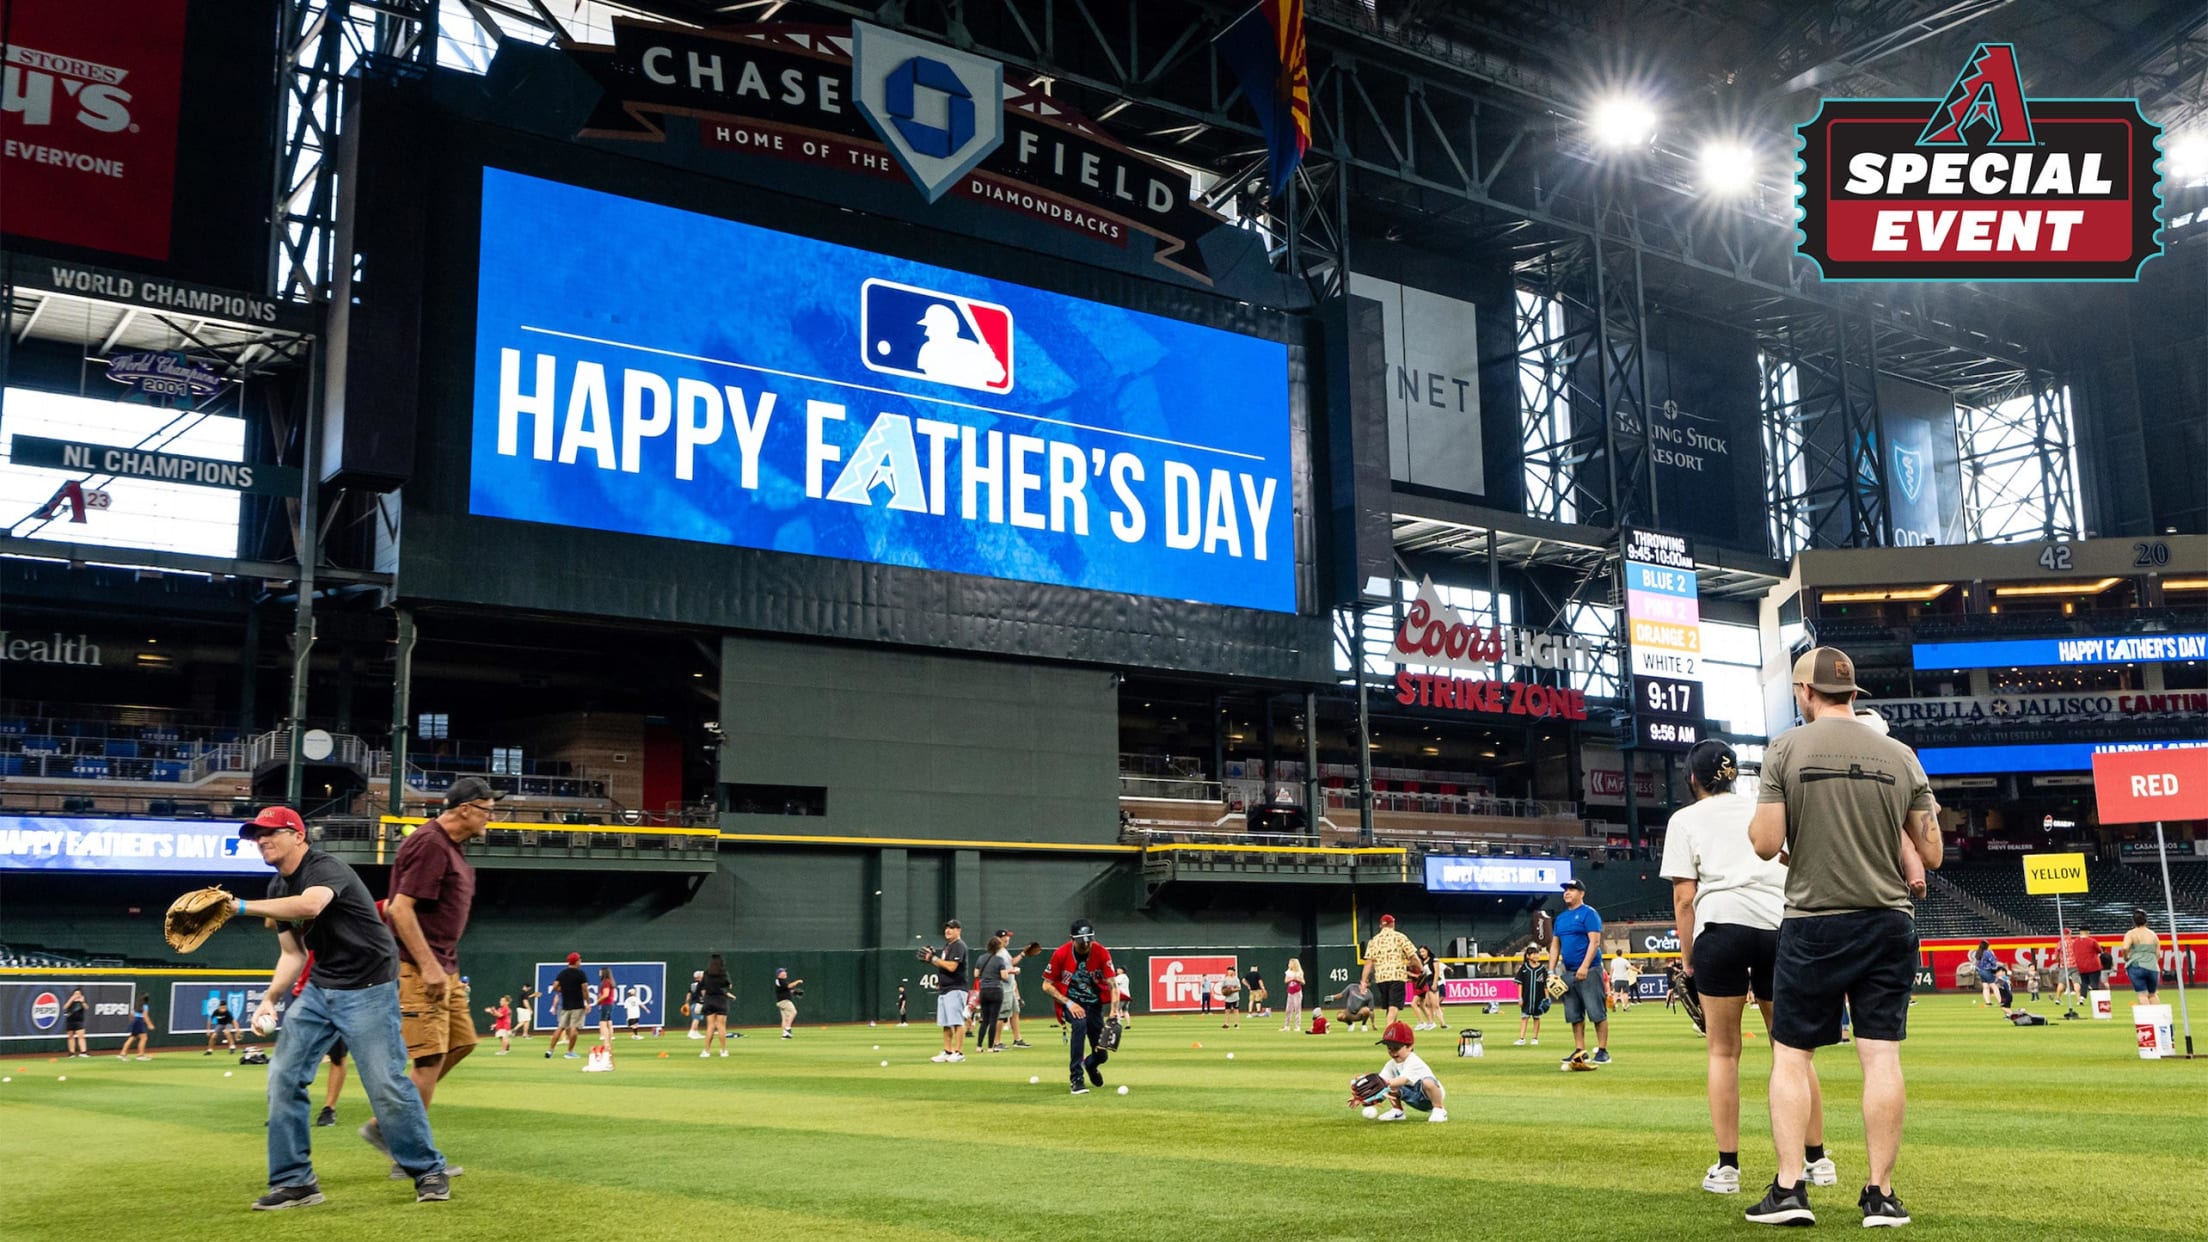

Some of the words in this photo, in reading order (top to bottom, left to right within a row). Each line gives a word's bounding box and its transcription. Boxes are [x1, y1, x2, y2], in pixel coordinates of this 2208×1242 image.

[19, 49, 118, 83] STORES
[641, 46, 842, 114] CHASE
[1018, 133, 1174, 214] FIELD
[5, 139, 124, 178] EVERYONE
[716, 127, 784, 151] HOME
[802, 142, 831, 159] OF
[848, 151, 890, 172] THE
[971, 180, 1121, 240] DIAMONDBACKS
[52, 267, 134, 298] WORLD
[141, 282, 277, 321] CHAMPIONS
[112, 354, 157, 372] World
[157, 355, 221, 385] Champions
[143, 378, 188, 396] 2001
[1386, 363, 1470, 413] NET
[1687, 427, 1728, 455] STICK
[63, 446, 95, 471] NL
[104, 450, 253, 487] CHAMPIONS
[497, 347, 777, 490] HAPPY
[806, 399, 1147, 544] FATHER'S
[1164, 460, 1277, 561] DAY
[87, 491, 110, 509] 23
[1633, 530, 1686, 553] THROWING
[2134, 541, 2170, 567] 20
[2040, 545, 2073, 570] 42
[1642, 569, 1674, 591] BLUE
[1677, 575, 1686, 592] 2
[1676, 601, 1686, 620] 2
[1396, 598, 1504, 662] Coors
[1505, 624, 1593, 673] LIGHT
[1636, 623, 1685, 647] ORANGE
[1688, 630, 1697, 649] 2
[2058, 640, 2103, 662] HAPPY
[2106, 638, 2177, 660] FATHER'S
[2178, 637, 2206, 658] DAY
[1643, 652, 1682, 673] WHITE
[1686, 658, 1694, 675] 2
[1396, 672, 1503, 711] STRIKE
[1507, 682, 1588, 721] ZONE
[1648, 681, 1690, 712] 9:17
[2016, 697, 2112, 716] JALISCO
[1650, 724, 1676, 742] 9:56
[1678, 727, 1695, 744] AM
[2131, 773, 2179, 797] RED
[176, 834, 221, 858] DAY
[2134, 842, 2178, 850] CASAMOS
[2031, 867, 2081, 881] YELLOW
[1330, 969, 1348, 981] 413
[1449, 983, 1497, 998] Mobile
[95, 1003, 129, 1015] PEPSI
